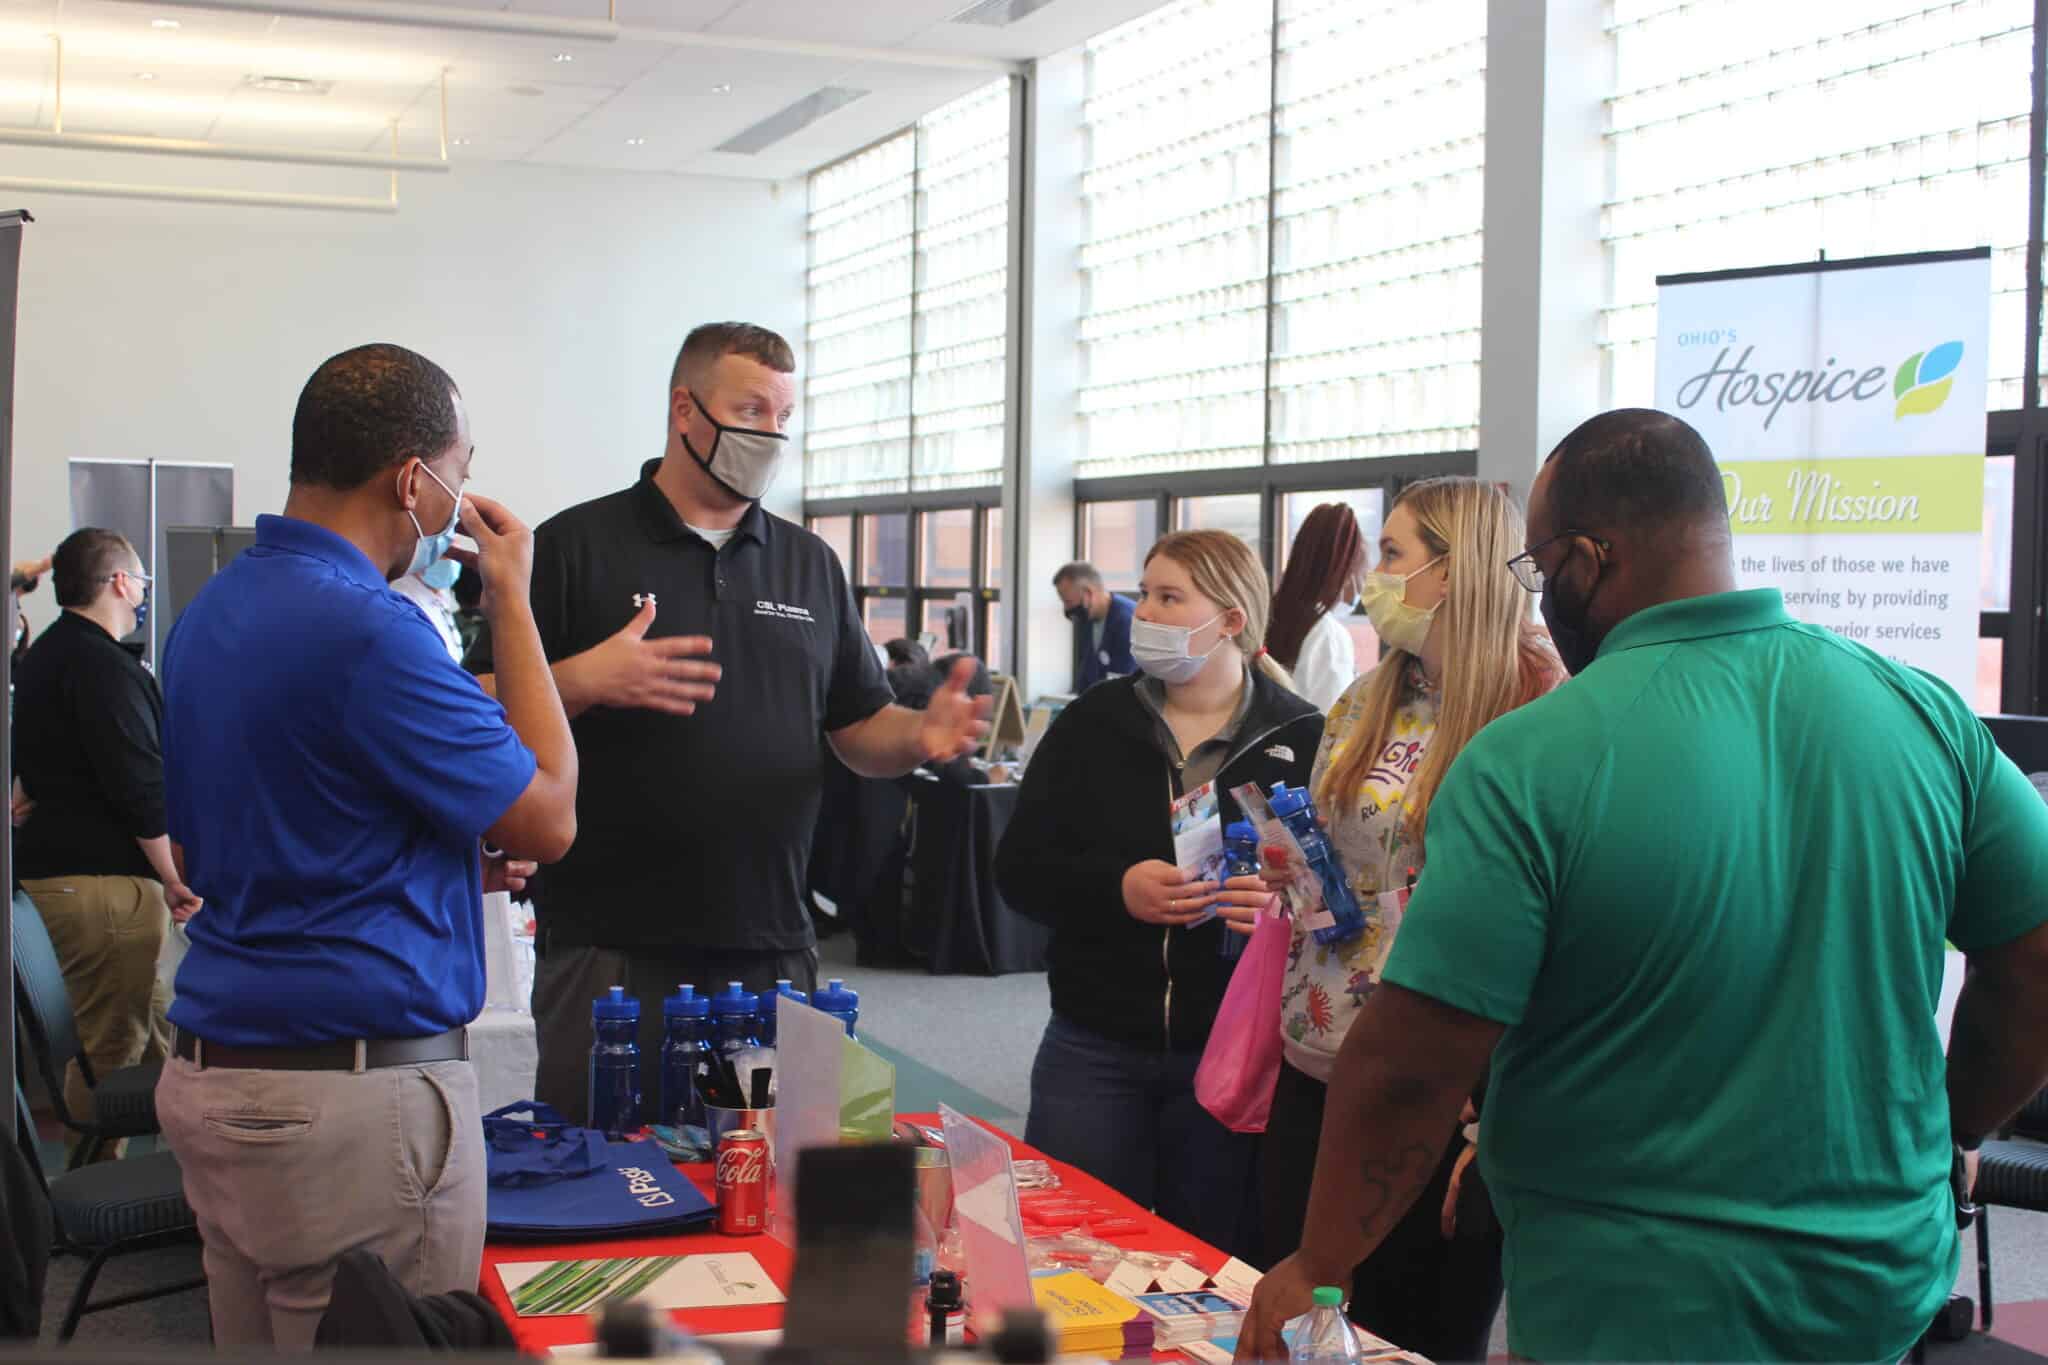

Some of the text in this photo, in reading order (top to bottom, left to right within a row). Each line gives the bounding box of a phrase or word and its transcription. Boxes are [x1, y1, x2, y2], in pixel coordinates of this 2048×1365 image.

[1678, 329, 1737, 346] OHIO'S
[1677, 345, 1887, 430] Hospice
[1787, 468, 1920, 521] Mission
[1741, 555, 1949, 573] the lives of those we have
[1784, 588, 1949, 610] serving by providing
[1875, 625, 1941, 640] services
[717, 1146, 764, 1184] Cola
